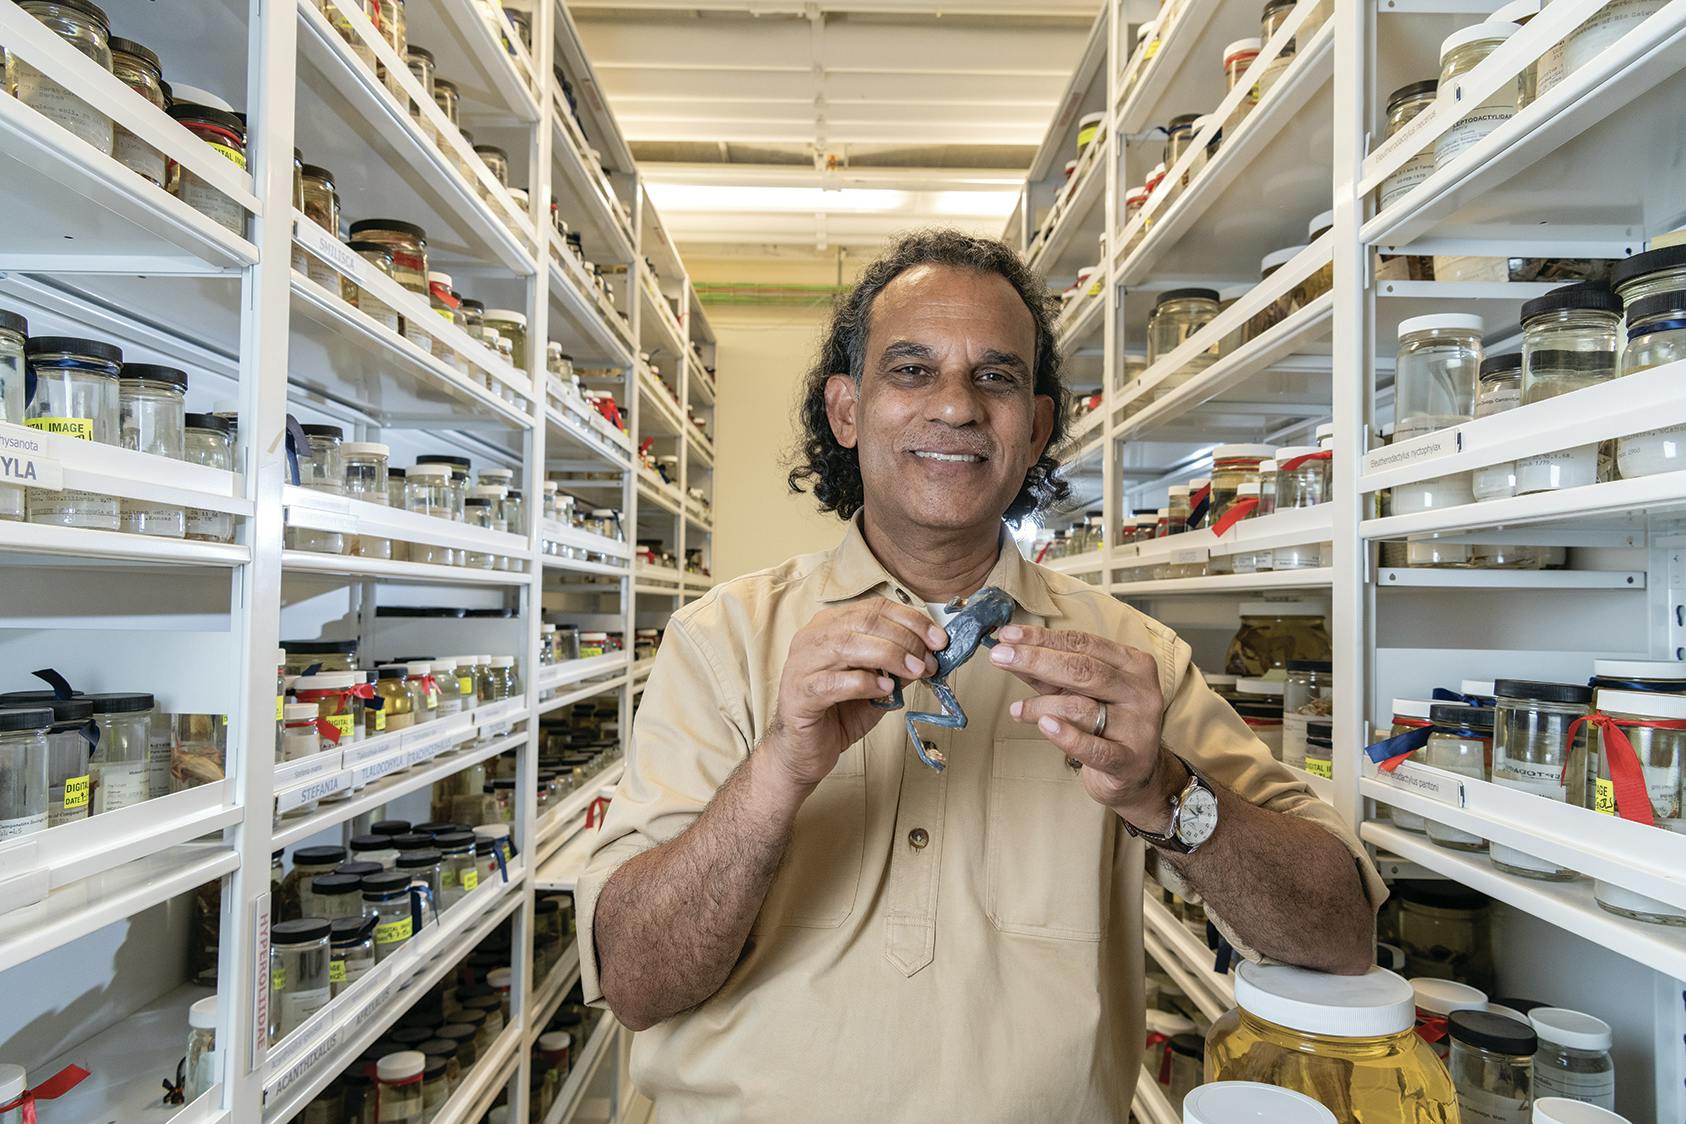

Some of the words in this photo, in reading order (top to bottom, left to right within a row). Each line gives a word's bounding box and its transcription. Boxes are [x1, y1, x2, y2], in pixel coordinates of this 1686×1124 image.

[319, 238, 355, 270] SMILISCA
[48, 422, 84, 433] IMAGE
[0, 455, 37, 480] YLA
[301, 778, 338, 803] STEFANIA
[276, 1034, 337, 1096] ACANTHIXALUS
